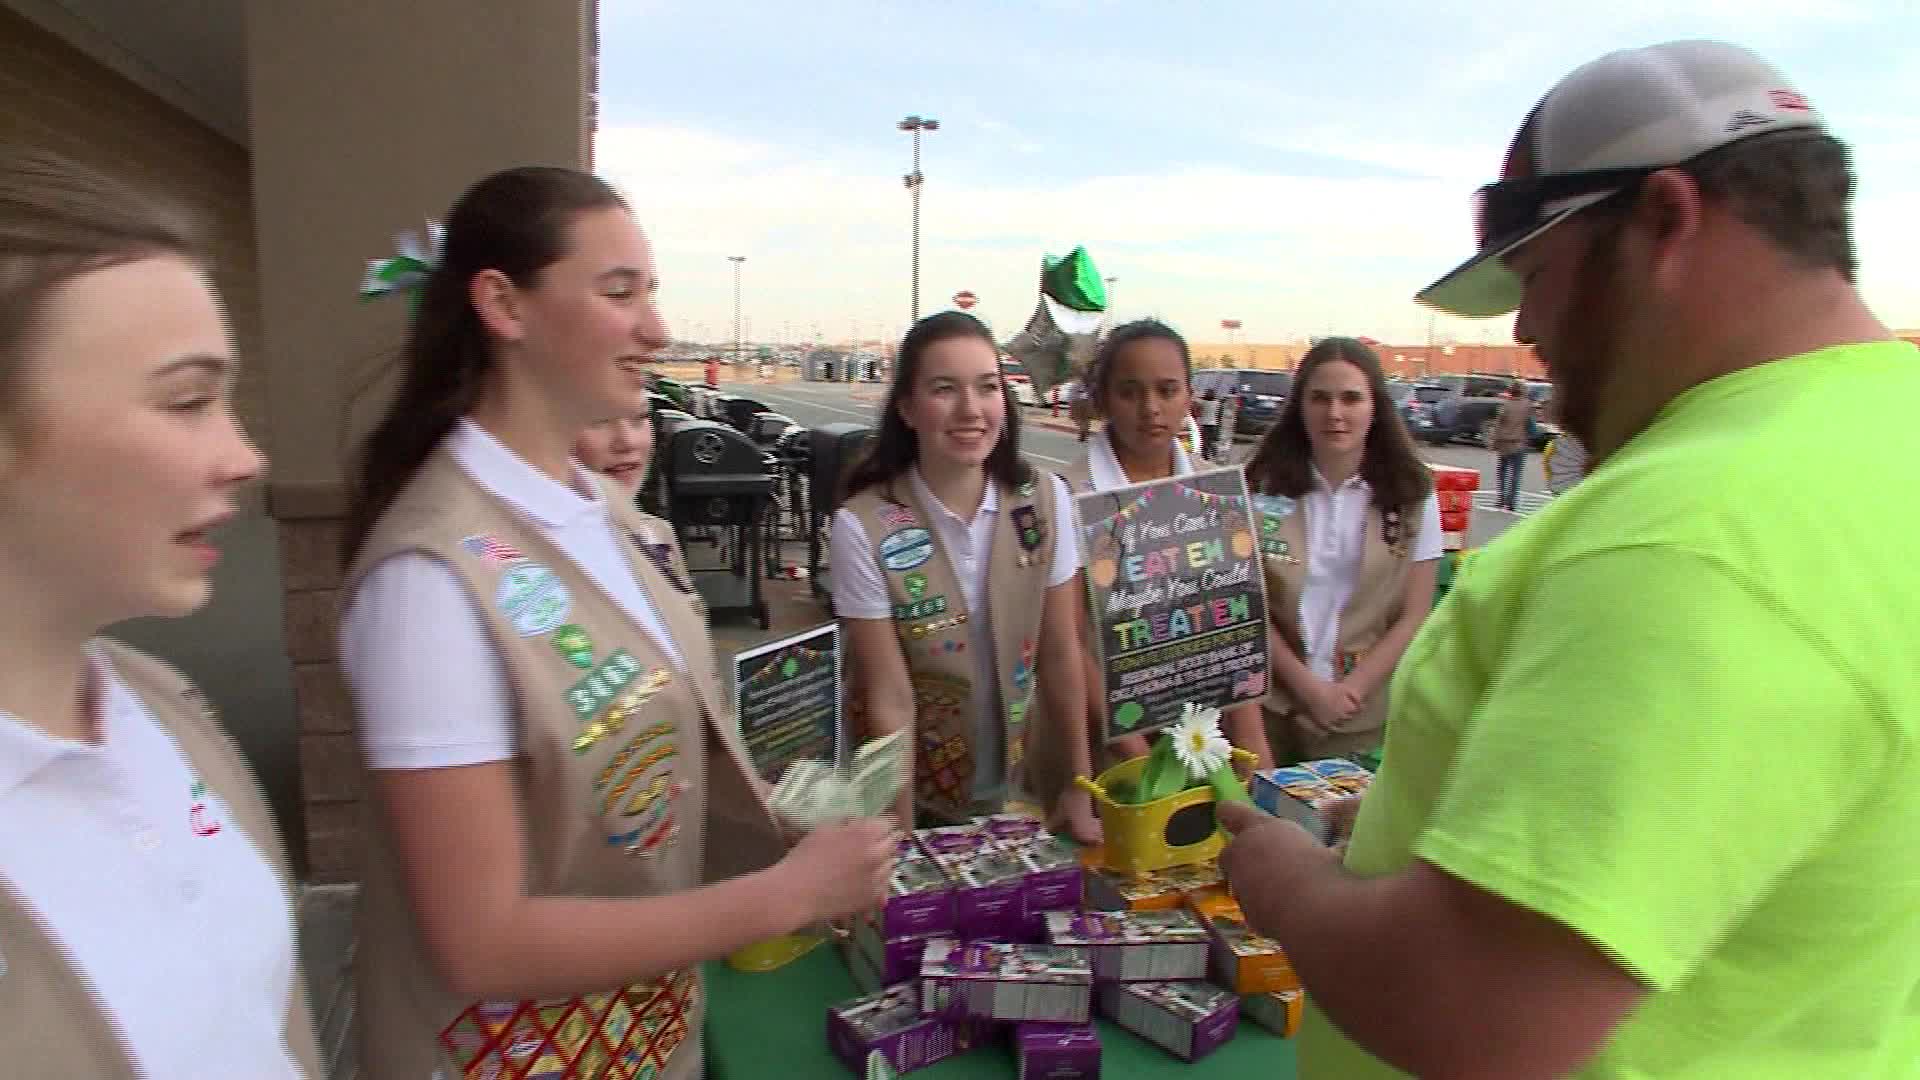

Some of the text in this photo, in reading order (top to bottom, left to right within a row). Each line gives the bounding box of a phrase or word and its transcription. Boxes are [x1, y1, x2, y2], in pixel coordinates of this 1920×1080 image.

[1122, 508, 1218, 552] If You Can't
[1126, 538, 1224, 582] EAT EM
[1106, 561, 1250, 617] Maybe You Could
[1112, 604, 1206, 650] TREAT
[1177, 653, 1208, 671] FOOD
[1209, 646, 1239, 663] BANK
[1240, 641, 1254, 655] OF
[1184, 668, 1207, 683] THE
